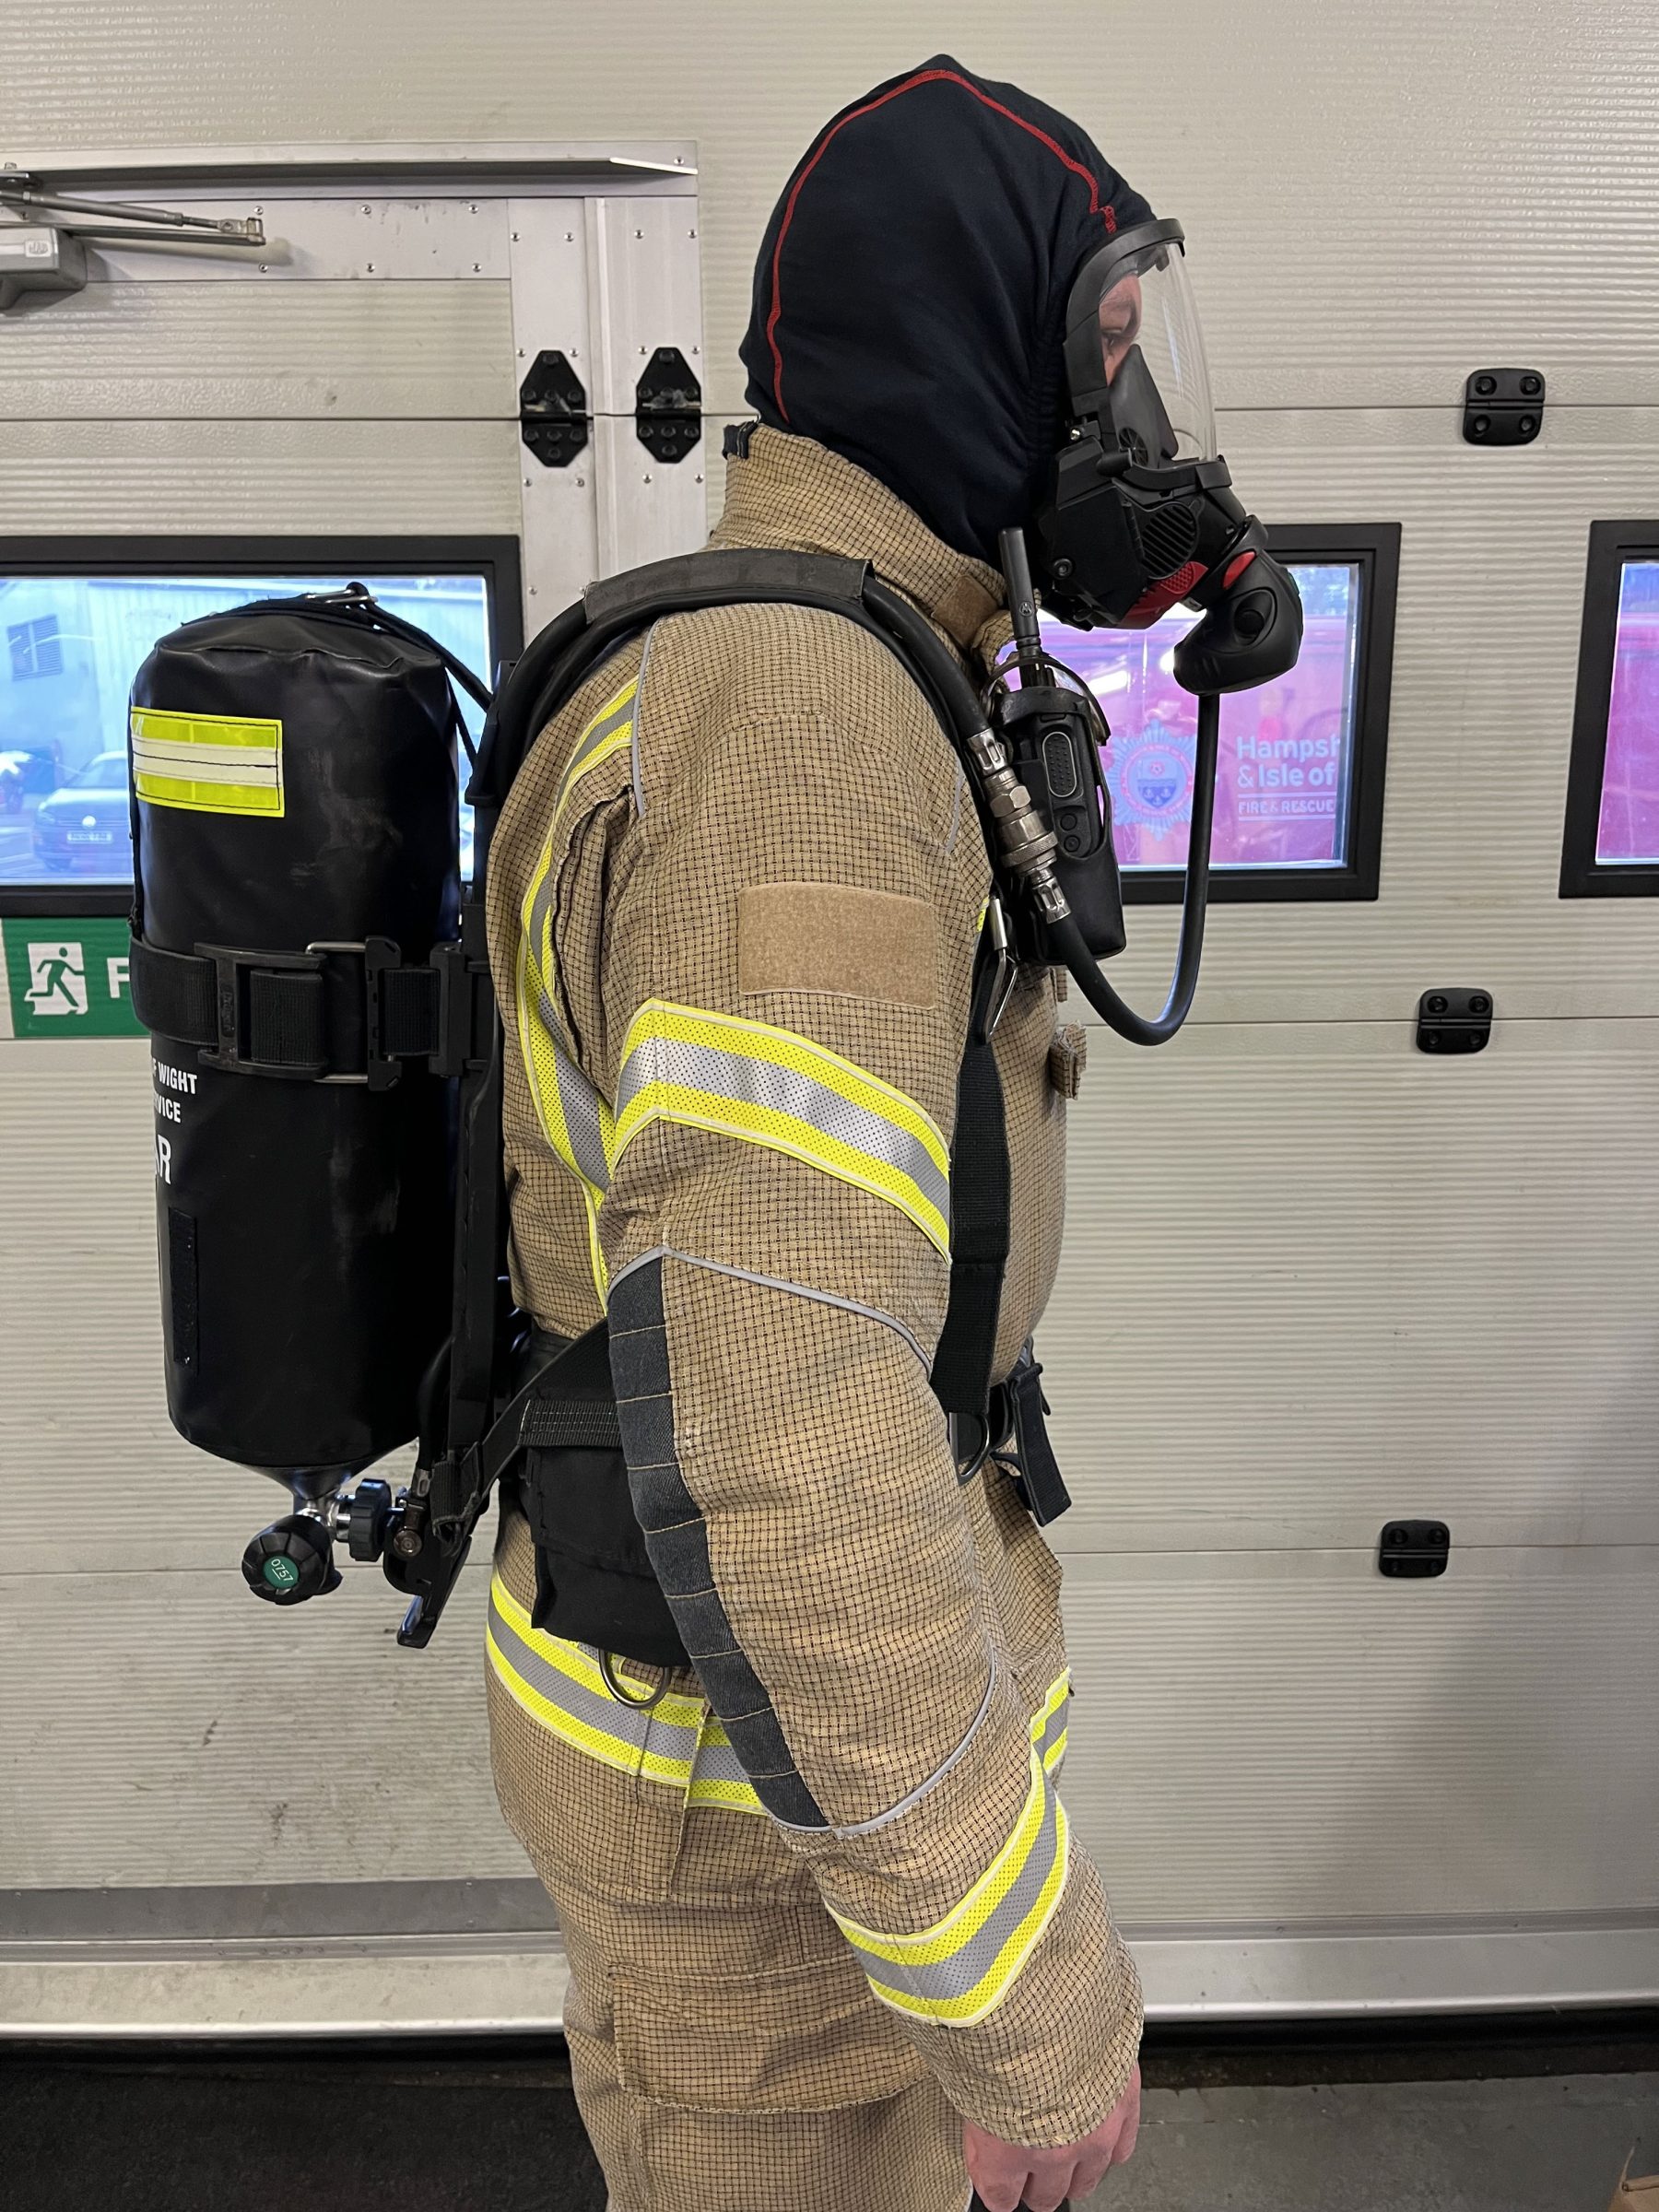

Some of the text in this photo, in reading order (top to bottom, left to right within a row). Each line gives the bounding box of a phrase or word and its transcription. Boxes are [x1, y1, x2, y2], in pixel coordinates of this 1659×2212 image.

[1238, 762, 1335, 788] & Isle of
[1238, 801, 1268, 815] FIRE
[1281, 799, 1335, 814] RESCUE
[158, 1061, 197, 1095] WIGHT
[271, 1559, 294, 1582] 0757
